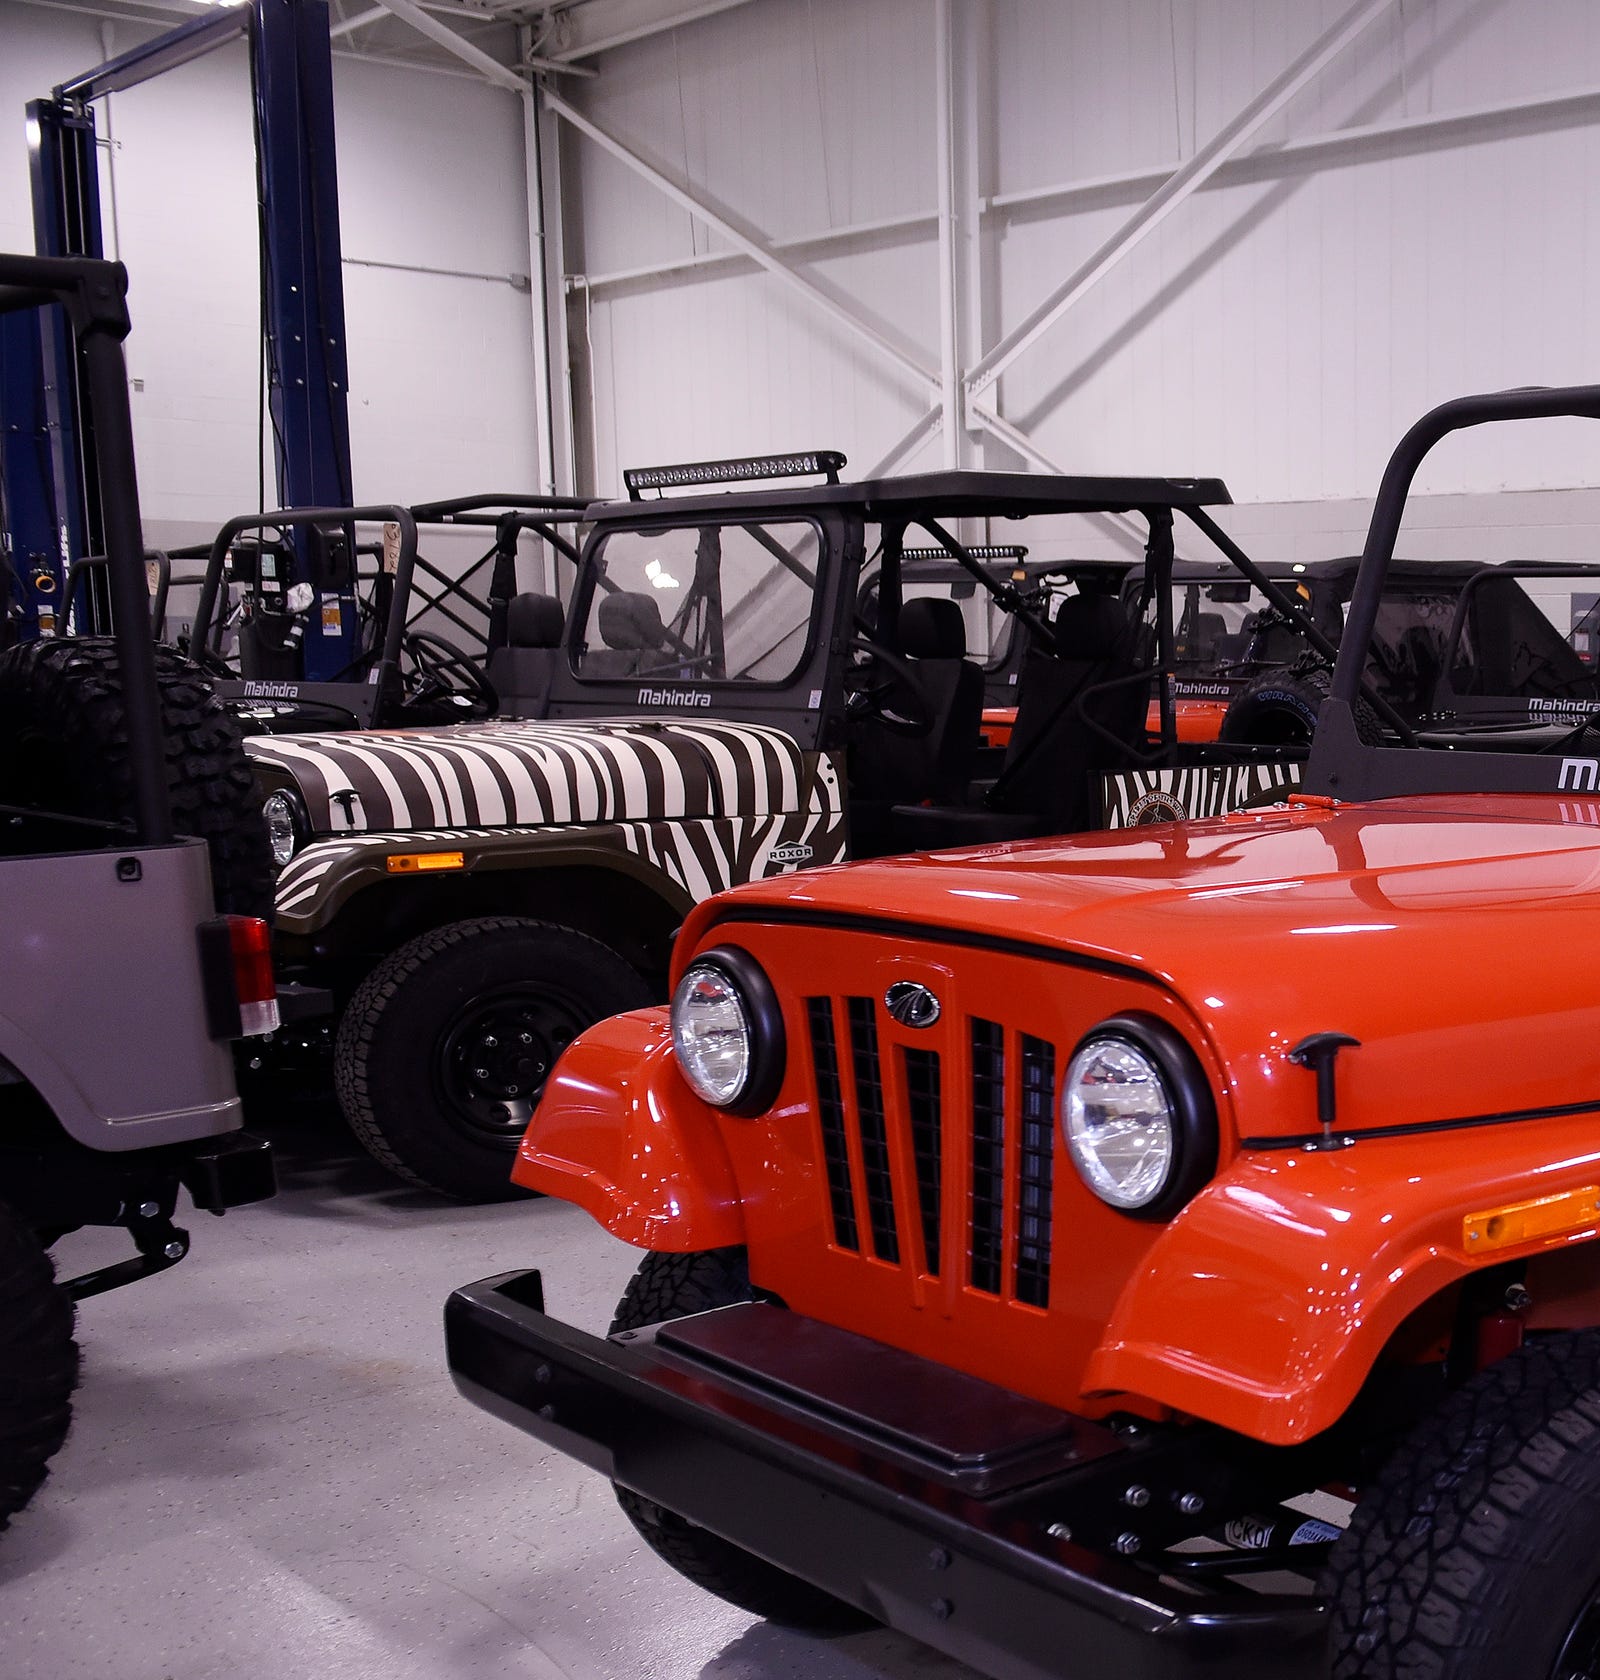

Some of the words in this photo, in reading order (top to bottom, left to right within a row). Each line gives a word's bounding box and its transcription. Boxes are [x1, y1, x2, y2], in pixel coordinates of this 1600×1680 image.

[244, 681, 298, 697] Mahindra
[1174, 682, 1230, 695] Mahindra
[638, 688, 712, 707] Mahindra
[769, 848, 812, 860] ROXOR
